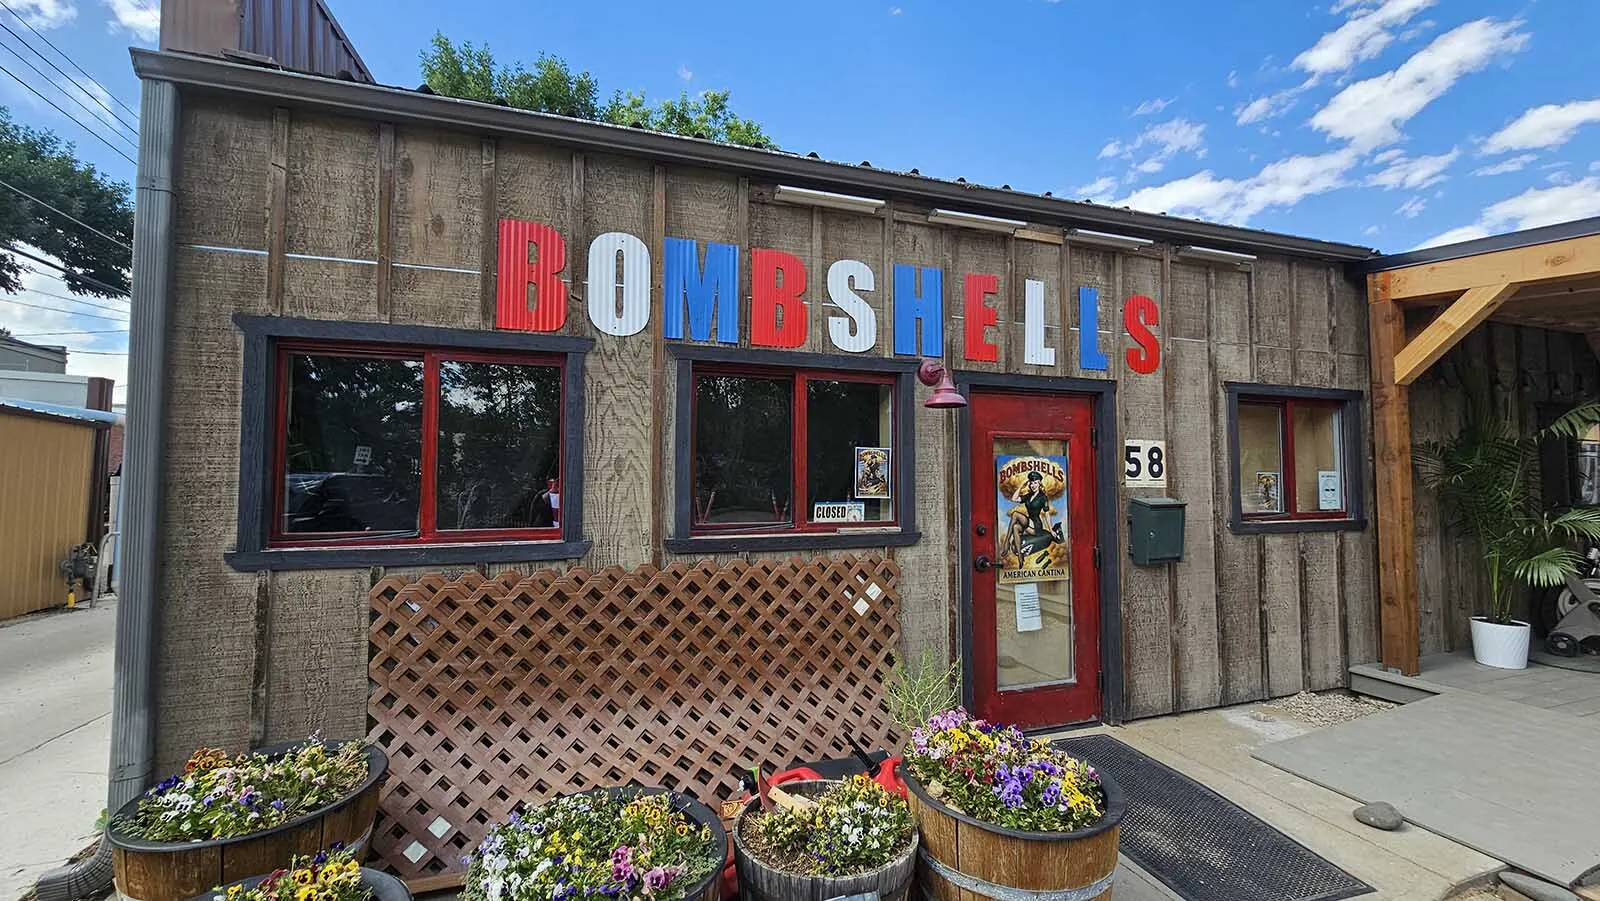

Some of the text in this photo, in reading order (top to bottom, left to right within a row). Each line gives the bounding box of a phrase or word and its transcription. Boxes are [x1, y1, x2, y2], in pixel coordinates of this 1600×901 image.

[496, 217, 1160, 375] BOMBSHELLS
[1000, 460, 1064, 483] BOMBSHELLS
[1125, 446, 1163, 478] 58
[816, 506, 847, 519] CLOSED
[1003, 568, 1065, 579] AMERICAN CANTINA
